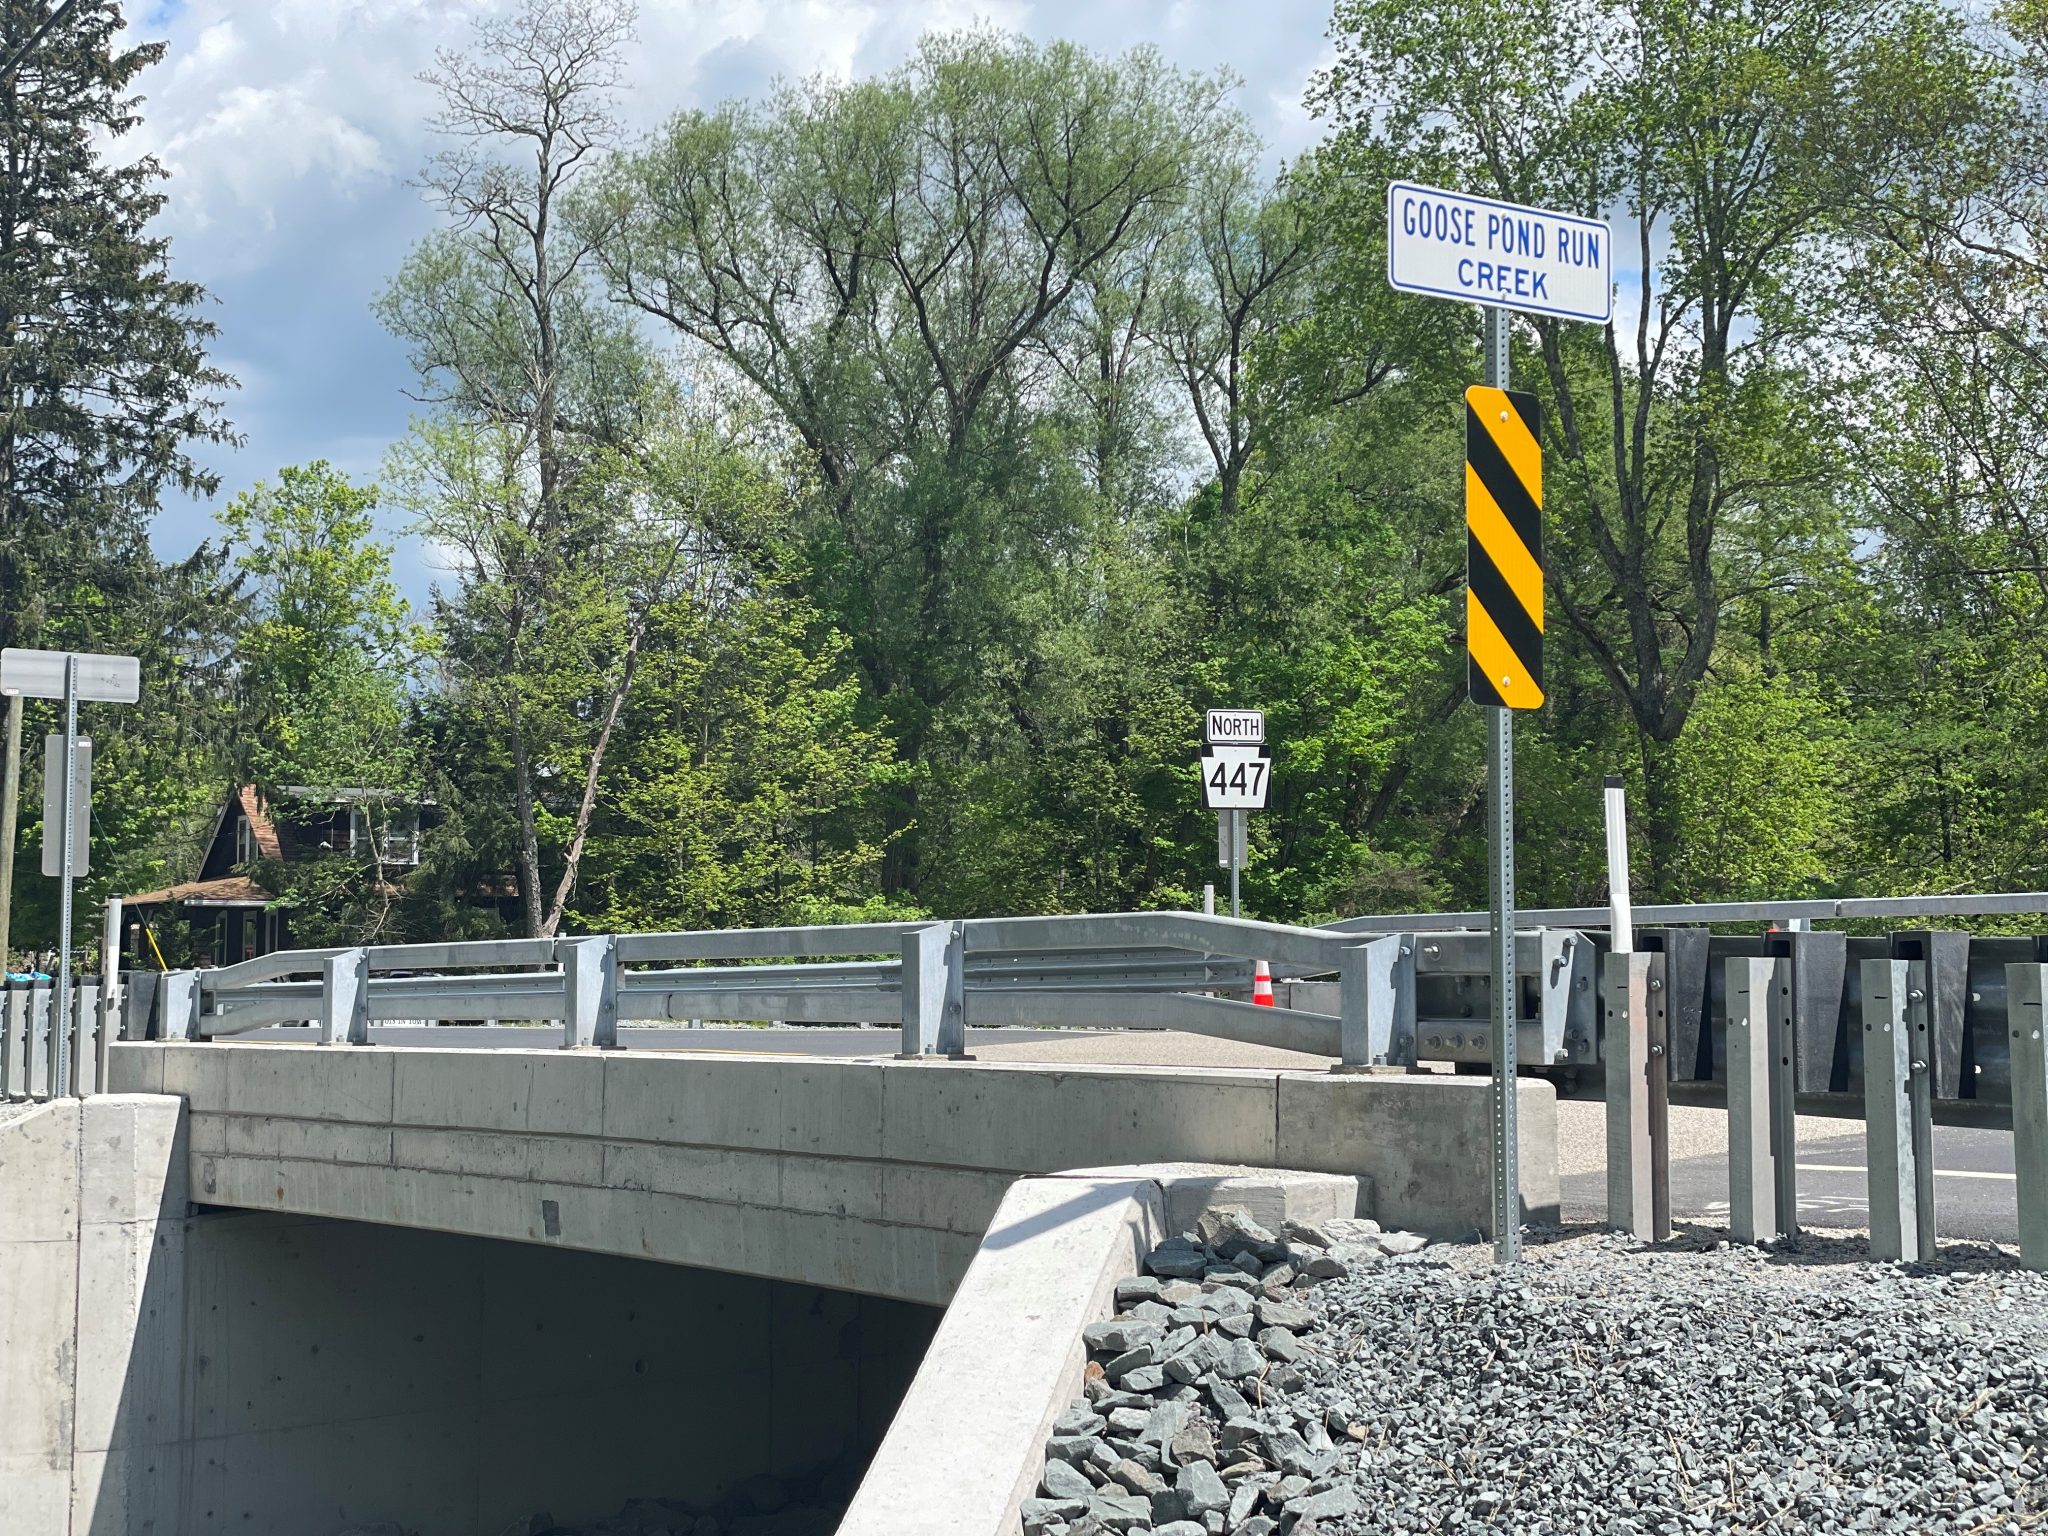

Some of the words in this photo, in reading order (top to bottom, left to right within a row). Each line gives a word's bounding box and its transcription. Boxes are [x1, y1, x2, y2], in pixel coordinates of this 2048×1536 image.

[1404, 198, 1475, 247] GOOSE
[1488, 214, 1545, 258] POND
[1558, 227, 1599, 269] RUN
[1458, 258, 1548, 299] CREEK
[1212, 715, 1259, 735] NORTH
[1209, 762, 1265, 796] 447
